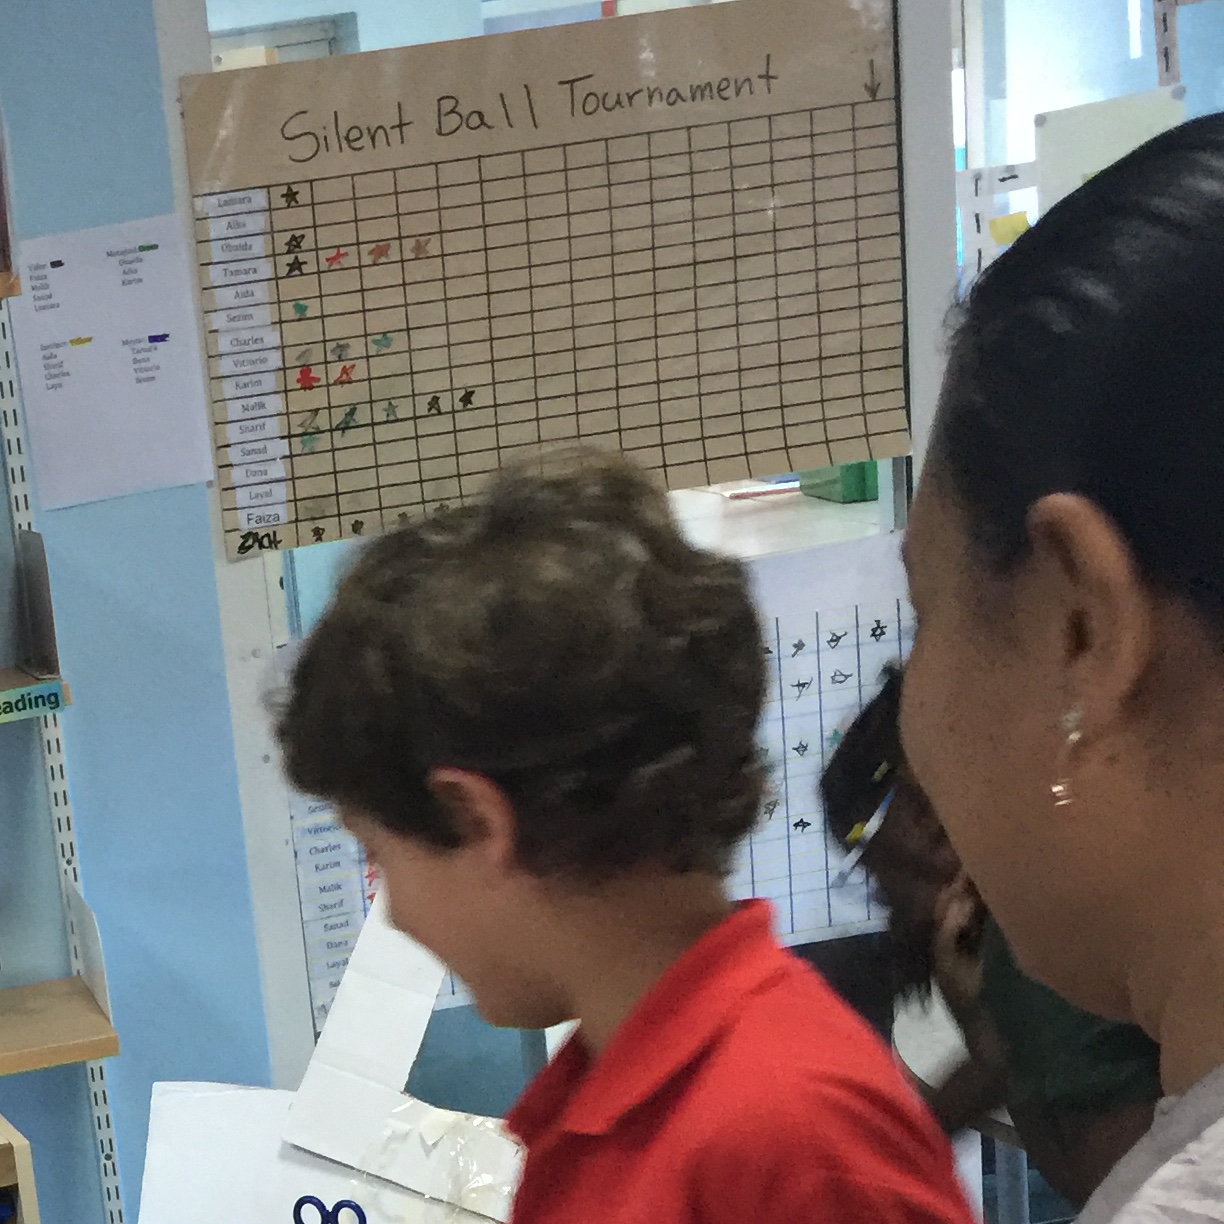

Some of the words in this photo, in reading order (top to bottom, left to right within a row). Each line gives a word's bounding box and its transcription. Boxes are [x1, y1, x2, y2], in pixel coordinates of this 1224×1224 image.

[281, 102, 414, 163] Silent
[436, 84, 539, 137] Ball
[559, 54, 779, 118] Tournament
[222, 267, 258, 277] Tamara
[230, 336, 264, 347] Charles
[235, 379, 262, 391] Karim
[246, 512, 280, 525] Faiza
[309, 843, 342, 856] Charles
[314, 860, 341, 873] Karim
[318, 883, 343, 895] Malik
[323, 919, 350, 933] Sanad
